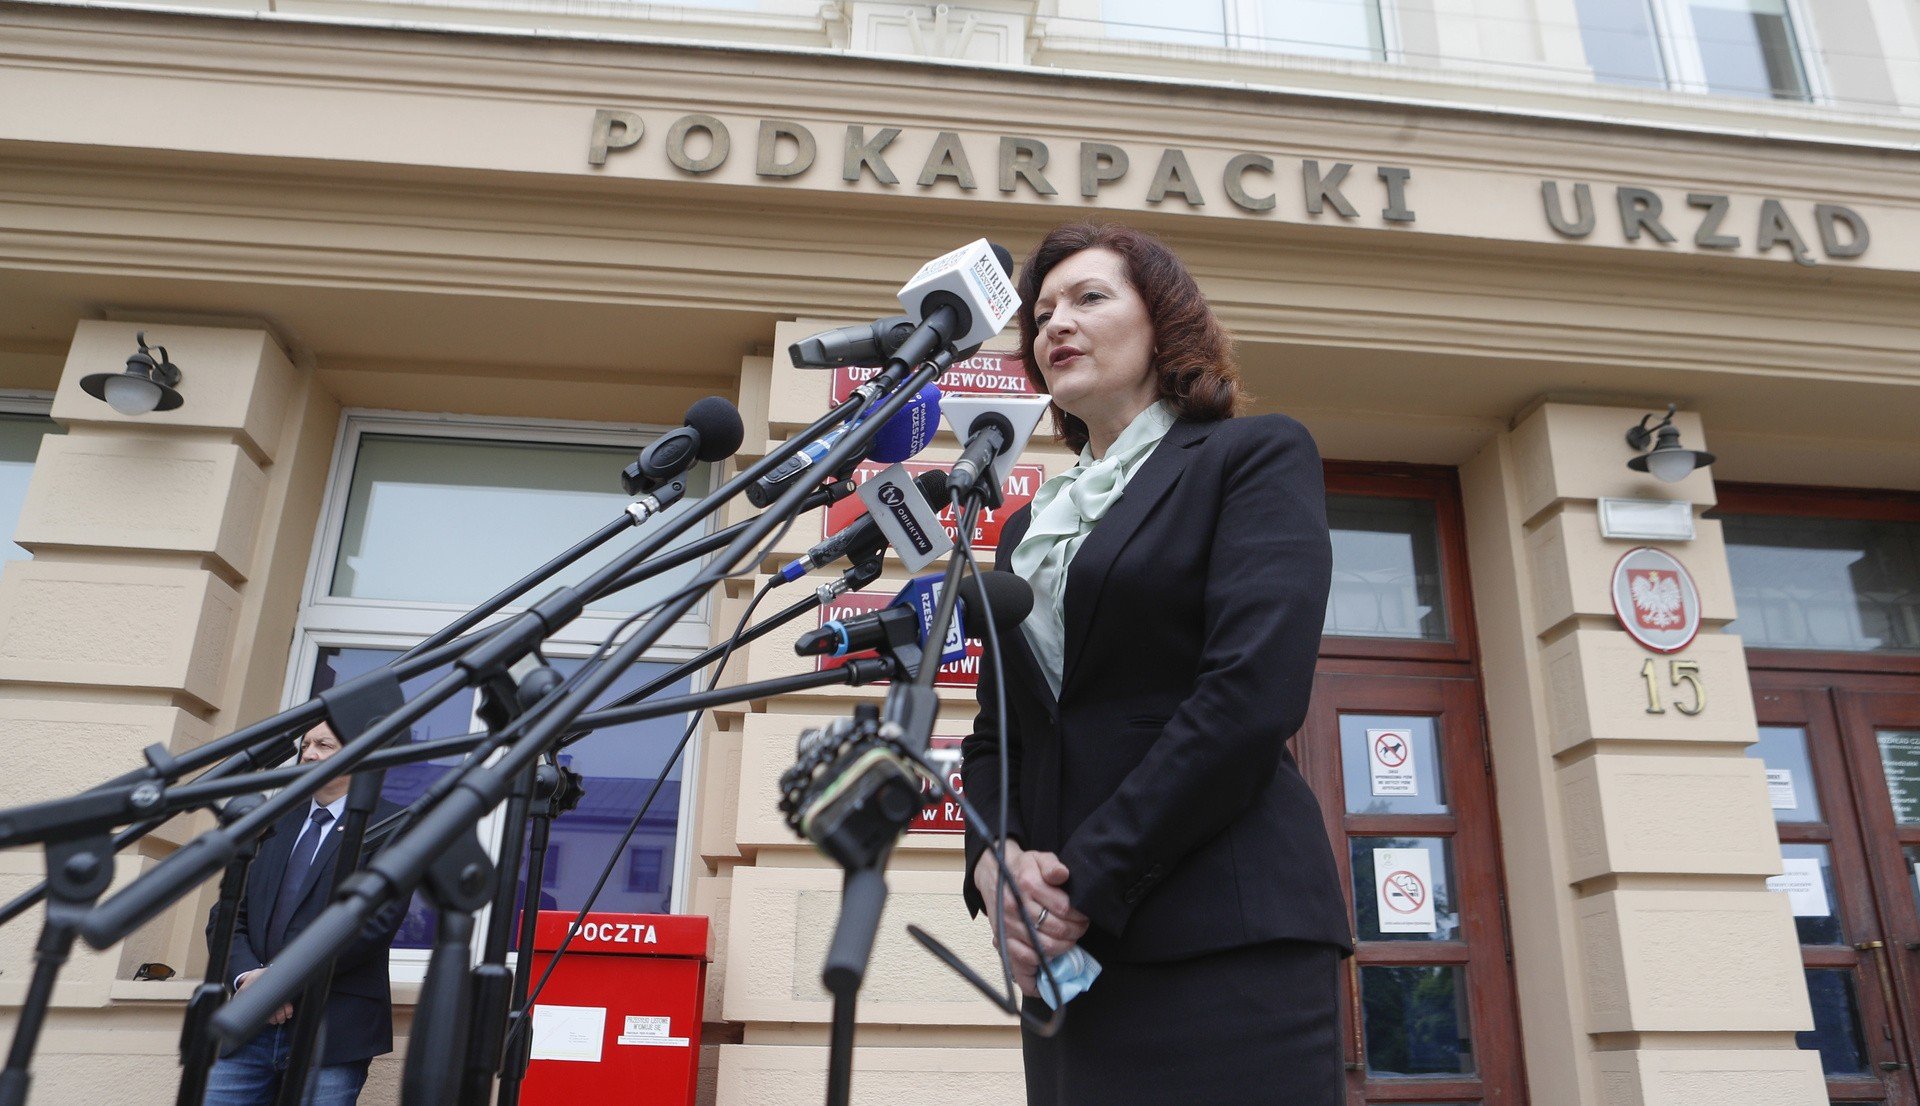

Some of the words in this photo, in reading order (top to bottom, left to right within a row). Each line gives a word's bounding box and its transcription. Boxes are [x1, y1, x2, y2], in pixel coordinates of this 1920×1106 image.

[588, 108, 1416, 222] PODKARPACKI
[1541, 180, 1870, 266] URZĄD
[979, 254, 1012, 307] KURIER
[898, 508, 927, 548] OBIEKTYW
[1641, 658, 1705, 716] 15
[568, 921, 657, 943] POCZTA
